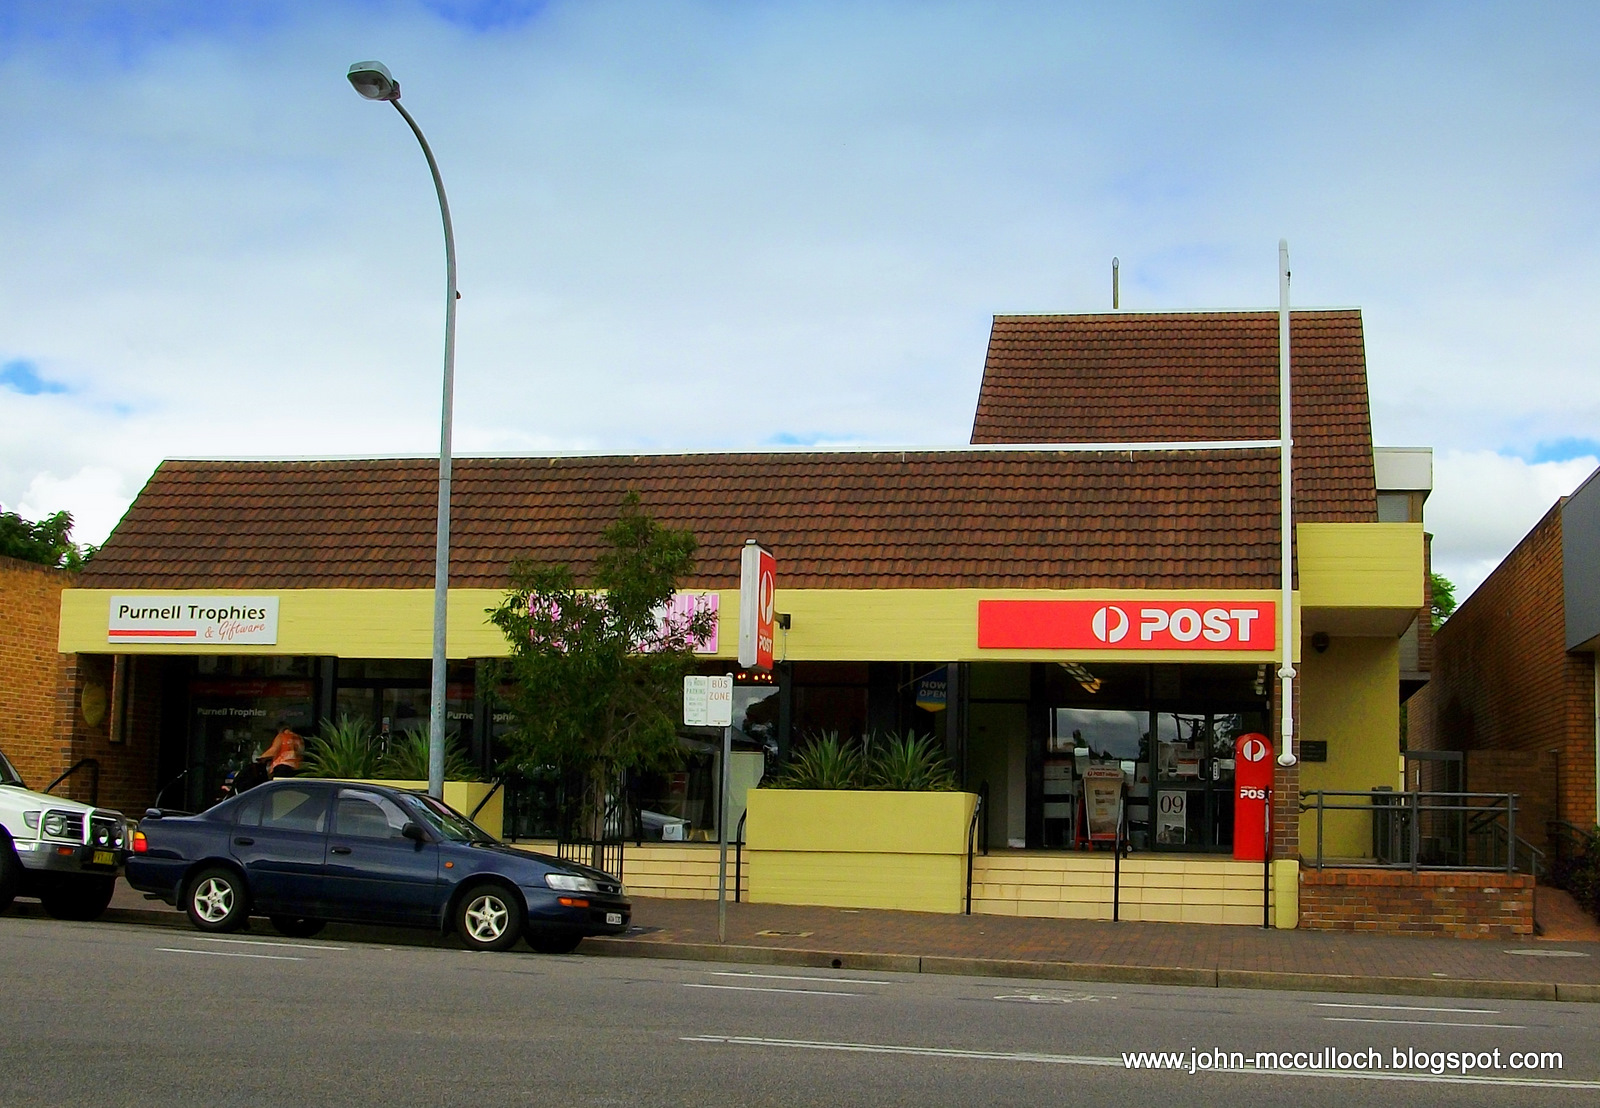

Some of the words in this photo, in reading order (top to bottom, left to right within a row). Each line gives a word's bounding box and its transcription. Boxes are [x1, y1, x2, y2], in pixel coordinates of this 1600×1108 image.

[118, 605, 181, 620] Purnell
[188, 605, 266, 624] Trophies
[204, 626, 214, 639] &
[218, 621, 265, 641] Giftware
[1140, 608, 1259, 643] POST
[758, 635, 773, 654] POST
[711, 680, 728, 689] BUS
[921, 680, 947, 690] NOW
[709, 692, 730, 701] ZONE
[919, 689, 947, 698] OPEN
[197, 707, 228, 717] Purnell
[229, 707, 267, 718] Trophies
[446, 711, 475, 720] Purne
[1160, 795, 1184, 814] 09
